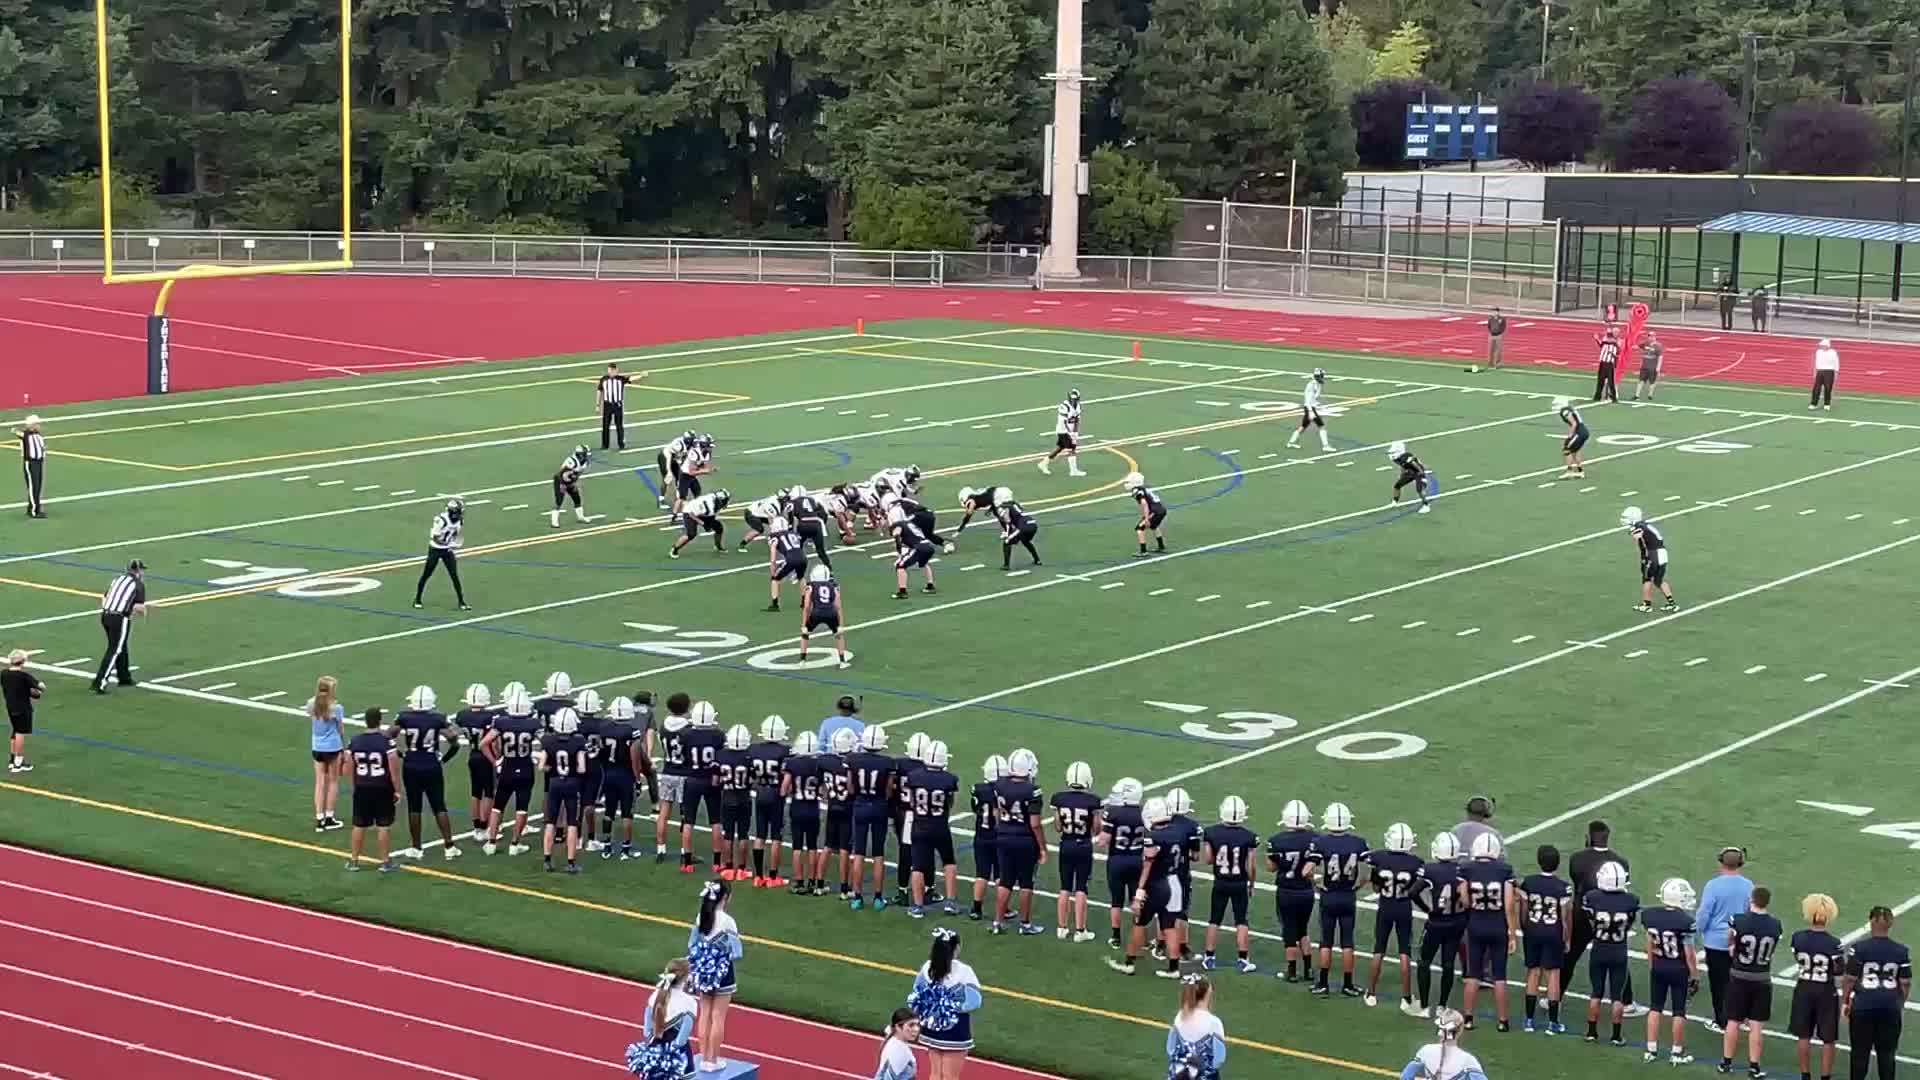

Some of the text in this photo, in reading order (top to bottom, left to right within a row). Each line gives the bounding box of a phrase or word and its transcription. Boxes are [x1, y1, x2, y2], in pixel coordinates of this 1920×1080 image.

[817, 585, 830, 604] 9
[406, 728, 435, 752] 74
[503, 731, 532, 758] 26
[795, 775, 818, 800] 16
[858, 768, 879, 795] 11
[1060, 807, 1089, 835] 35
[1216, 845, 1240, 875] 41
[1378, 869, 1412, 899] 32
[1738, 934, 1776, 966] 30
[1861, 961, 1899, 990] 63
